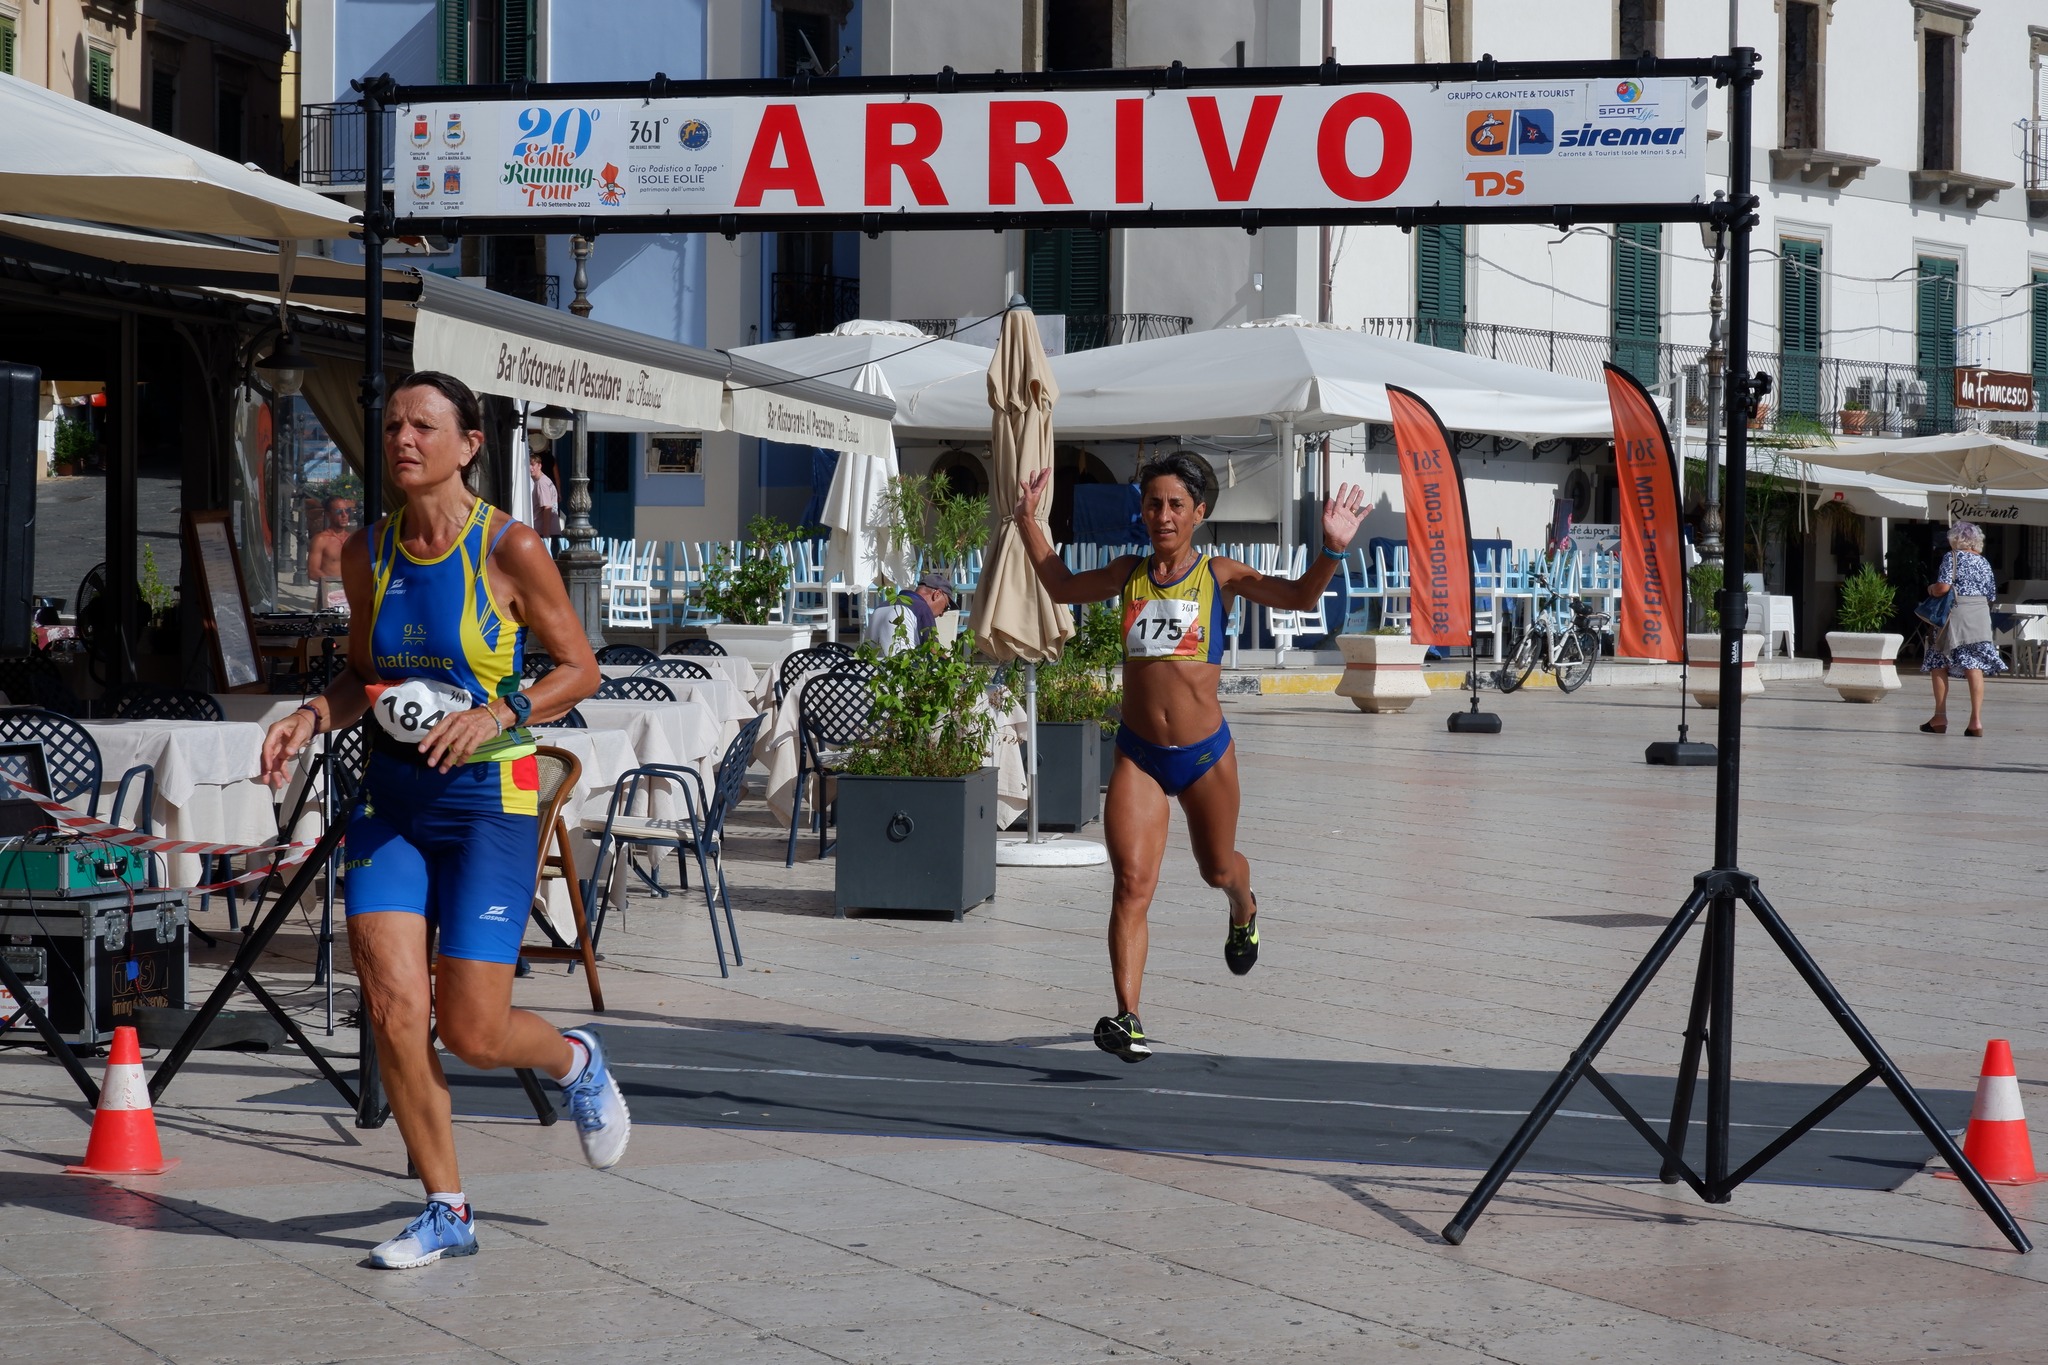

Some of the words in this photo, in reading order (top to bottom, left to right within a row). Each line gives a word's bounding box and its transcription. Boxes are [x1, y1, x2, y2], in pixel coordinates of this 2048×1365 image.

[1447, 91, 1483, 100] GRUPPO
[1485, 90, 1528, 99] CARONTE
[1529, 90, 1536, 98] &
[1537, 89, 1575, 97] TOURIST
[1598, 107, 1643, 115] SPORT
[629, 117, 669, 143] 361°
[1558, 123, 1685, 147] siremar
[523, 143, 576, 167] Eolie
[736, 93, 1412, 207] ARRIVO
[499, 160, 594, 189] Running
[628, 164, 646, 173] Giro
[649, 164, 683, 173] Podistico
[694, 164, 718, 173] Tappe
[638, 175, 669, 184] ISOLE
[673, 174, 705, 183] EOLIE
[521, 183, 579, 207] Tour
[1465, 170, 1525, 197] TDS
[496, 342, 518, 382] Bar
[517, 346, 566, 393] Ristorante
[566, 358, 580, 395] Al
[578, 361, 622, 401] Pescatore
[1961, 372, 1975, 400] da
[1975, 371, 2028, 407] Francesco
[767, 401, 777, 429] Bar
[776, 403, 805, 434] Ristorante
[812, 411, 835, 440] Pescatore
[1569, 525, 1582, 534] afé
[1583, 525, 1593, 535] du
[1594, 528, 1610, 537] port
[403, 623, 427, 637] g.s.
[1136, 618, 1182, 641] 175
[376, 651, 454, 670] natisone
[382, 695, 446, 732] 184
